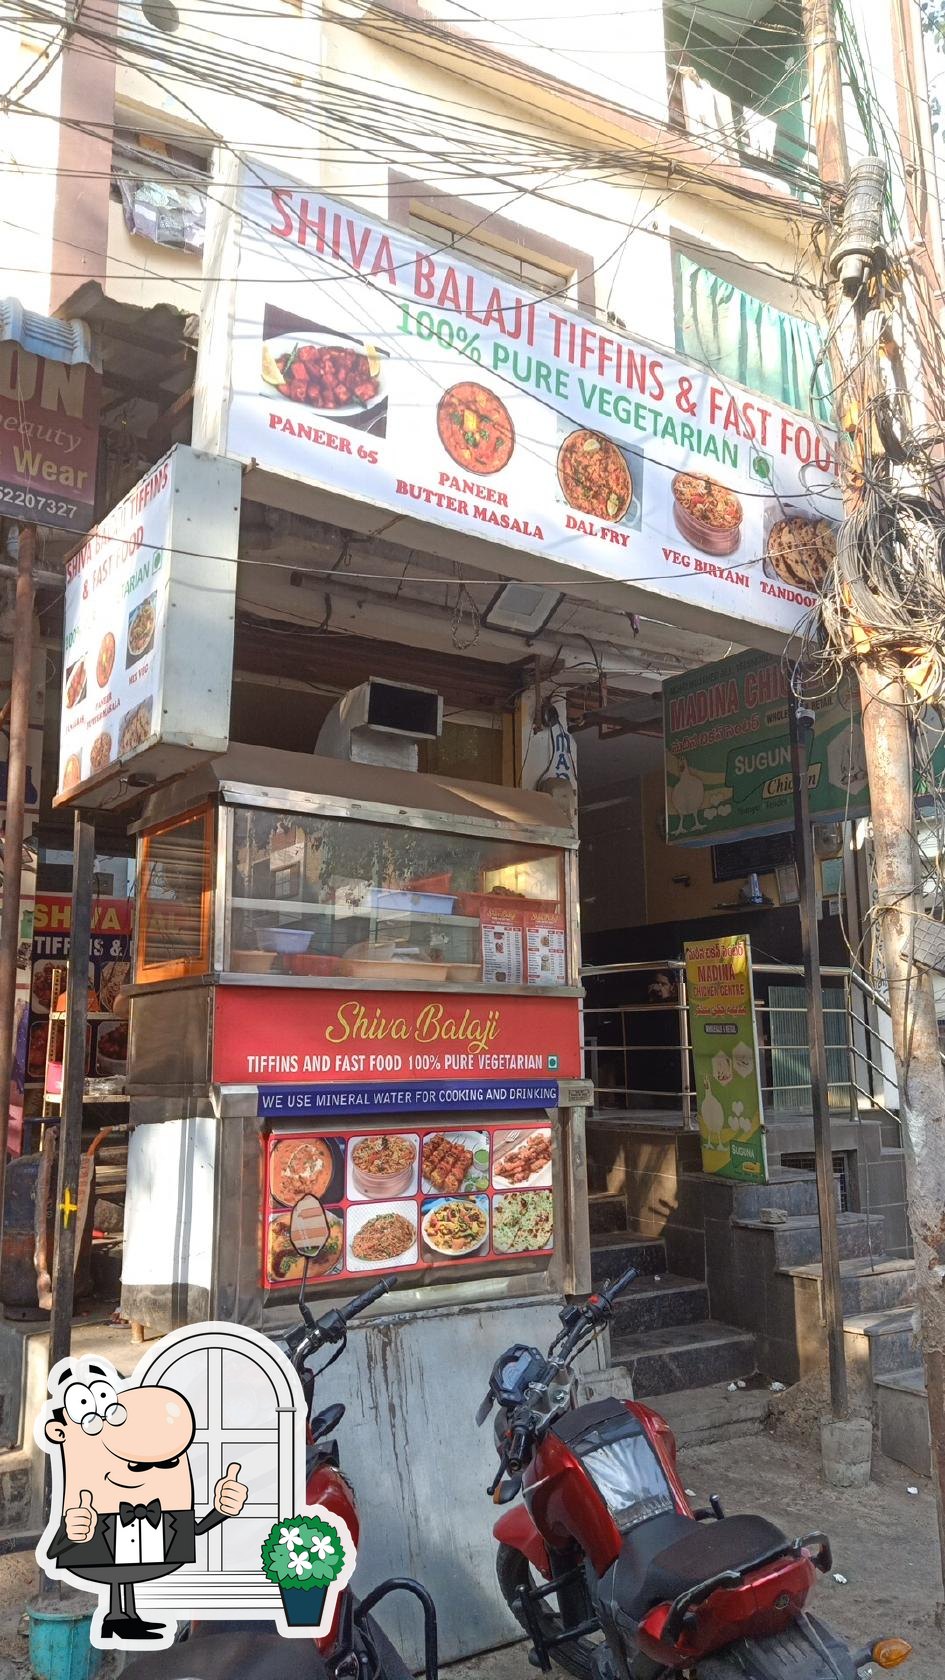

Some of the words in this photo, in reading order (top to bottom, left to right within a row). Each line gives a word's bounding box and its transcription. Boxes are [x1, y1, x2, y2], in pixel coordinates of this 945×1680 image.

[270, 188, 397, 286] SHIVA
[413, 250, 535, 347] BALAJI
[549, 312, 664, 402] TIFFINS
[675, 376, 697, 417] &
[710, 386, 772, 447] FAST
[781, 418, 839, 477] FOO
[397, 302, 481, 362] 100%
[493, 342, 570, 400] PURE
[578, 378, 738, 469] VEGETARIAN
[0, 414, 81, 453] eauty
[269, 413, 354, 455] PANEER
[357, 445, 379, 464] 65
[13, 445, 89, 489] Wear
[438, 472, 509, 507] PANEER
[67, 542, 92, 584] SHIVA
[131, 462, 169, 520] TIFFINS
[395, 479, 471, 518] BUTTER
[472, 498, 544, 540] MASALA
[565, 515, 599, 538] DAL
[600, 526, 631, 547] FRY
[662, 547, 691, 568] VEG
[694, 558, 750, 588] BIRYANI
[82, 579, 89, 600] &
[670, 679, 740, 732] MADINA
[735, 746, 791, 775] SUGUN
[767, 775, 816, 795] Chicn
[34, 904, 121, 930] SHVA
[34, 935, 104, 956] TIFFS
[110, 939, 123, 957] &
[697, 964, 736, 982] MADINA
[720, 983, 745, 996] CENTRE
[325, 1001, 411, 1043] Shiva
[414, 1003, 501, 1054] Balaji
[247, 1055, 299, 1073] TIFFINS
[303, 1055, 331, 1072] AND
[335, 1055, 366, 1071] FAST
[370, 1055, 402, 1071] FOOD
[408, 1055, 441, 1070] 100%
[444, 1054, 474, 1070] PURE
[478, 1054, 543, 1070] VEGETARIAN
[262, 1095, 283, 1109] WE
[287, 1094, 312, 1108] USE
[316, 1093, 370, 1106] MINERAL
[373, 1092, 411, 1104] WATER
[415, 1091, 436, 1103] FOR
[438, 1089, 483, 1102] COOKING
[486, 1088, 507, 1100] AND
[509, 1087, 557, 1100] DRINKING
